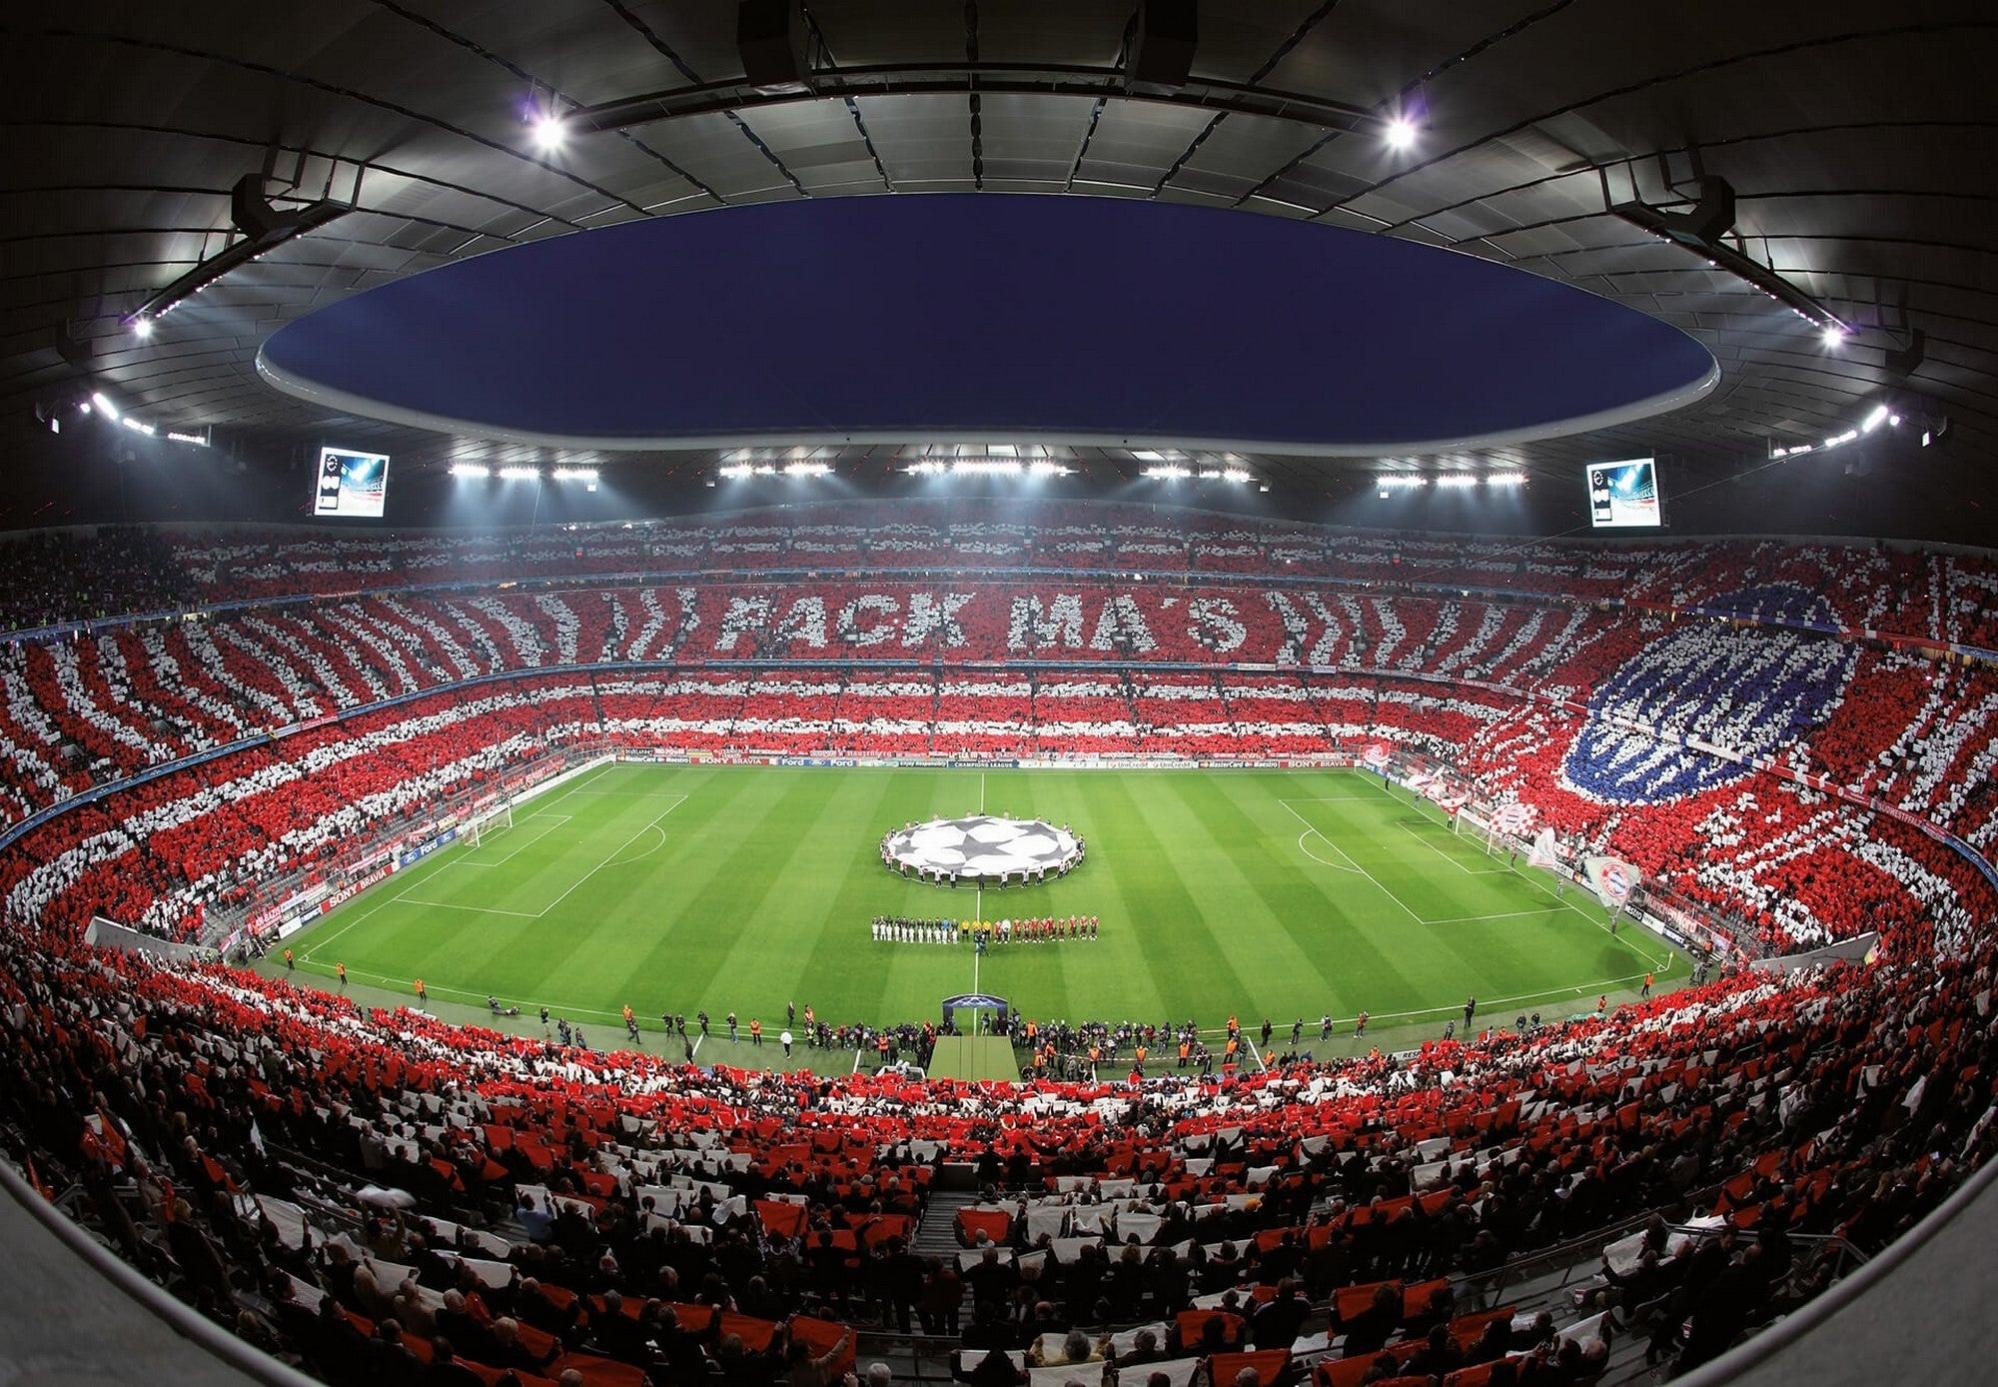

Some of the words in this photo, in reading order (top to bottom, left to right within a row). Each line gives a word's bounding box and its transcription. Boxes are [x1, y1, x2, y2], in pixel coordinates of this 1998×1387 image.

[782, 758, 804, 766] Ford
[830, 758, 853, 766] Ford
[1288, 760, 1317, 768] SONY
[421, 840, 438, 855] Ford
[329, 885, 358, 907] SONY
[360, 872, 386, 889] BRAVIA
